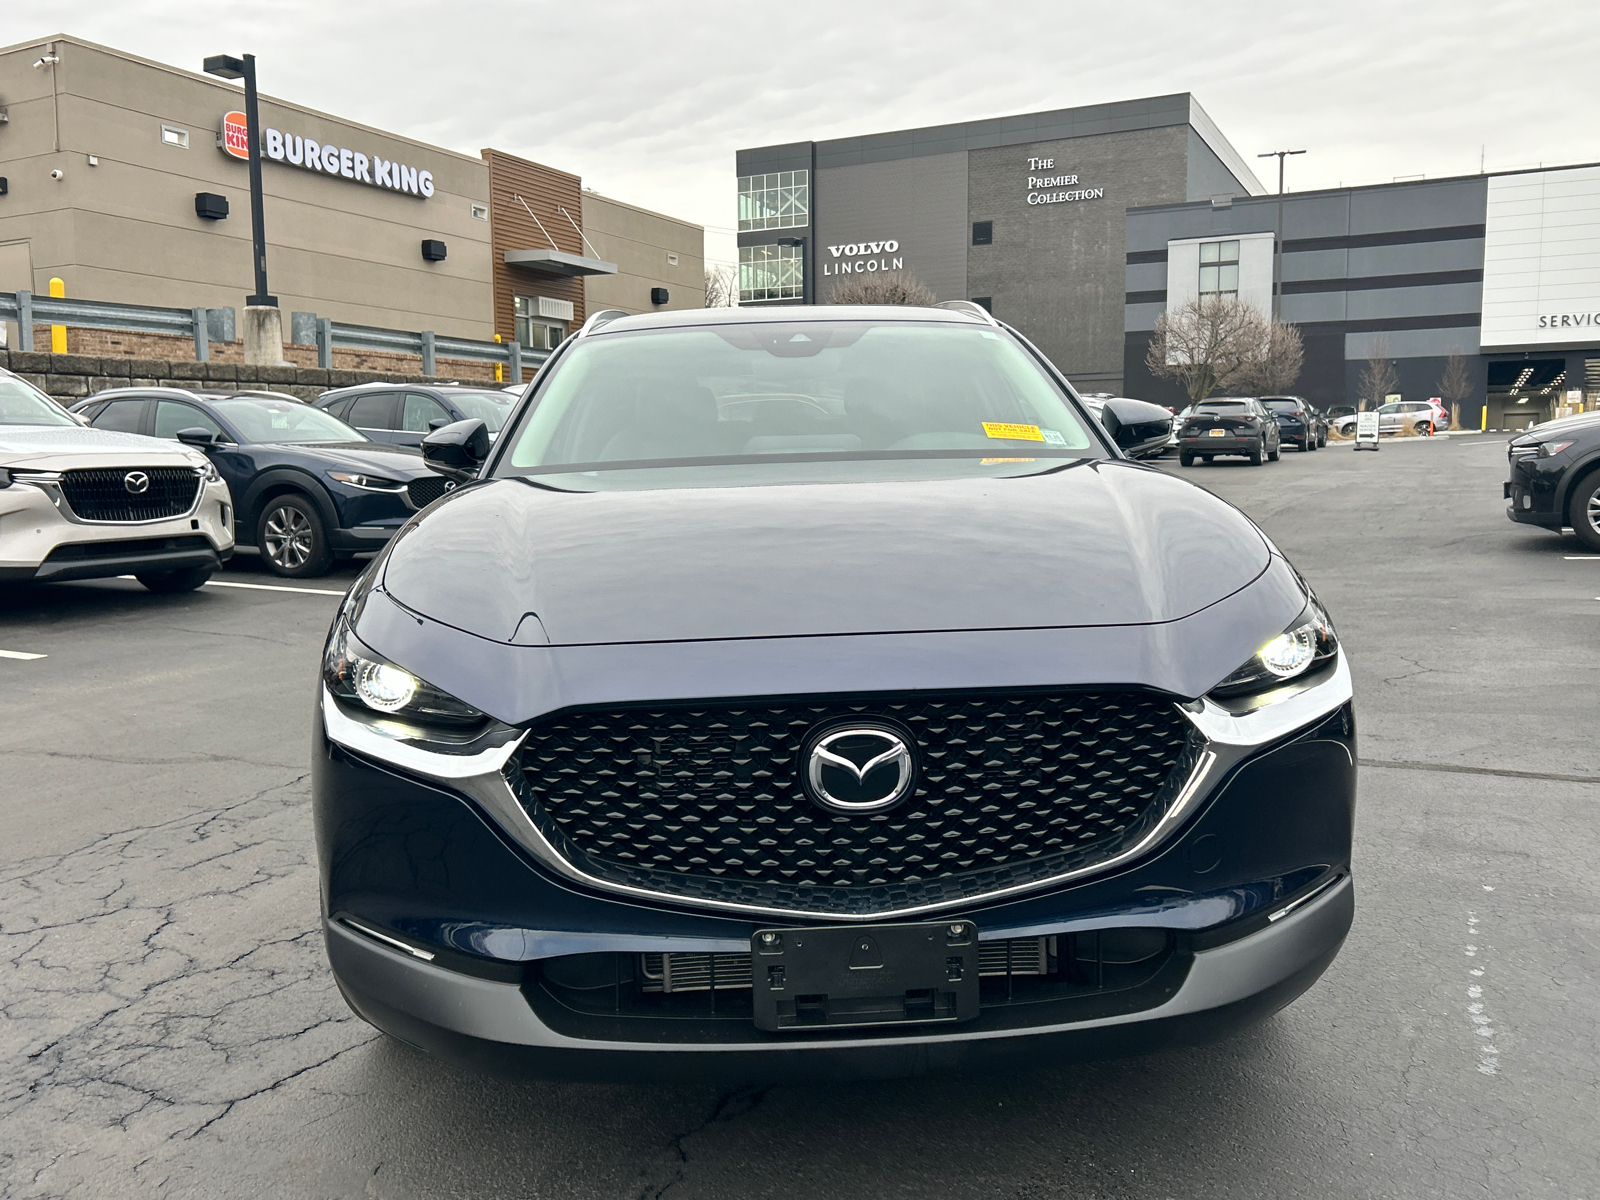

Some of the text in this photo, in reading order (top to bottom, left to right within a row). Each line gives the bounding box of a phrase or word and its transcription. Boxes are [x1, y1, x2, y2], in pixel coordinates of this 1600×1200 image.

[226, 122, 248, 137] BURG
[226, 132, 249, 150] KIN
[266, 128, 435, 198] BURGER KING
[1027, 174, 1079, 190] PREMIER
[1027, 187, 1104, 205] COLLECTION
[827, 240, 899, 258] VOLVO
[823, 257, 903, 276] LINCOLN
